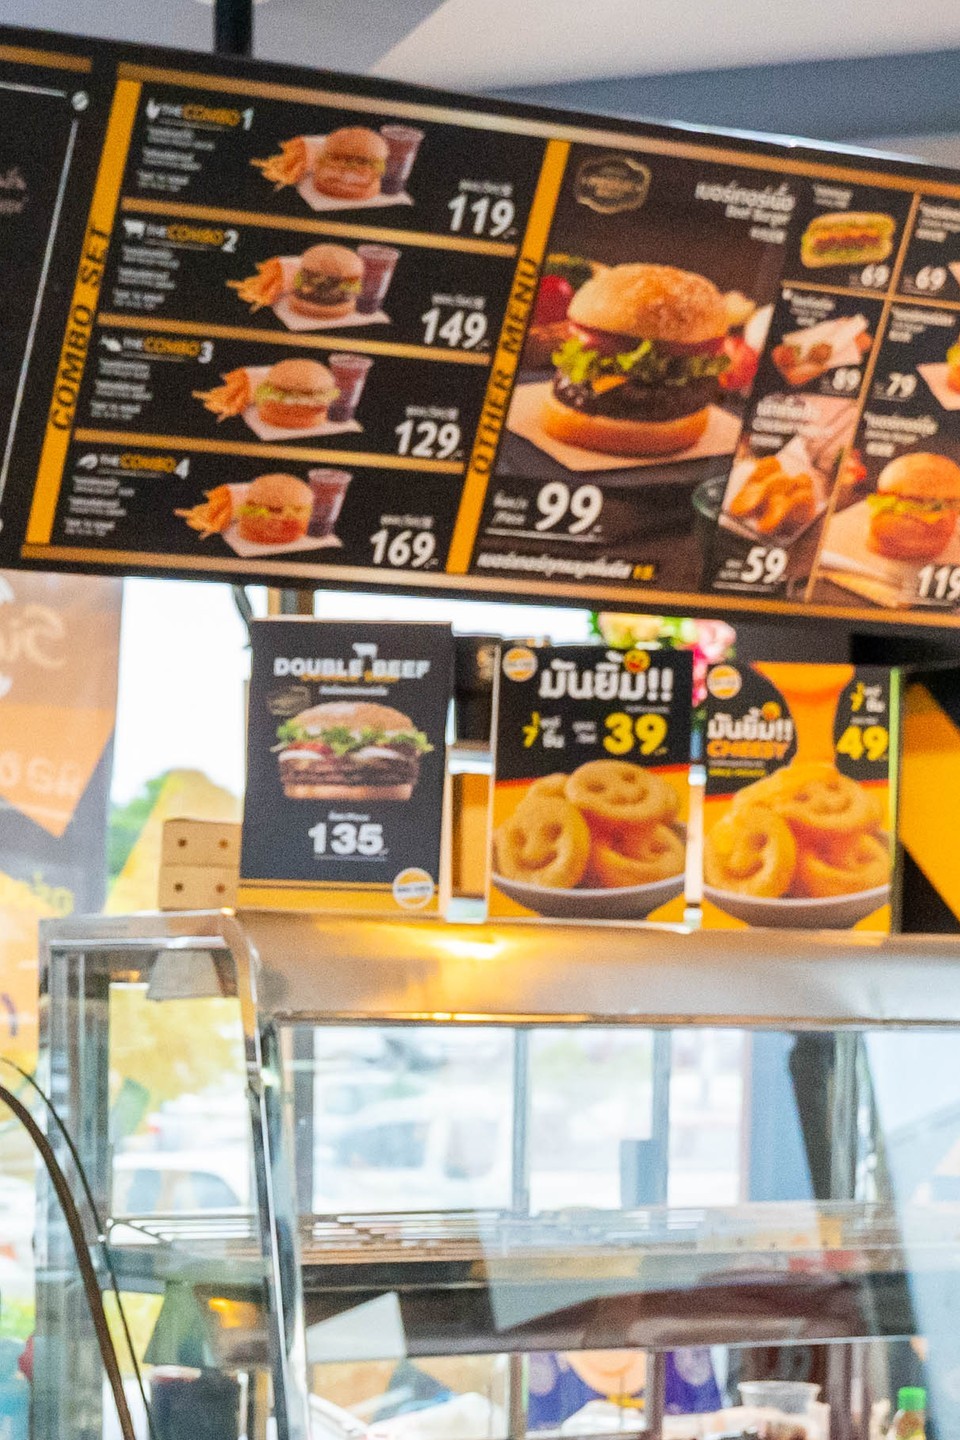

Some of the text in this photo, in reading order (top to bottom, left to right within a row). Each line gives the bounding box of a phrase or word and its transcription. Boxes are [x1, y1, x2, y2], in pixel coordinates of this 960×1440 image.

[242, 108, 254, 131] 1
[223, 230, 239, 251] 2
[52, 227, 109, 430] COMBO SET
[199, 341, 214, 364] 3
[474, 369, 514, 475] OTHER
[502, 257, 539, 354] MENU
[175, 459, 190, 480] 4
[273, 657, 432, 679] DOUBLE BEEF
[307, 821, 384, 856] 135
